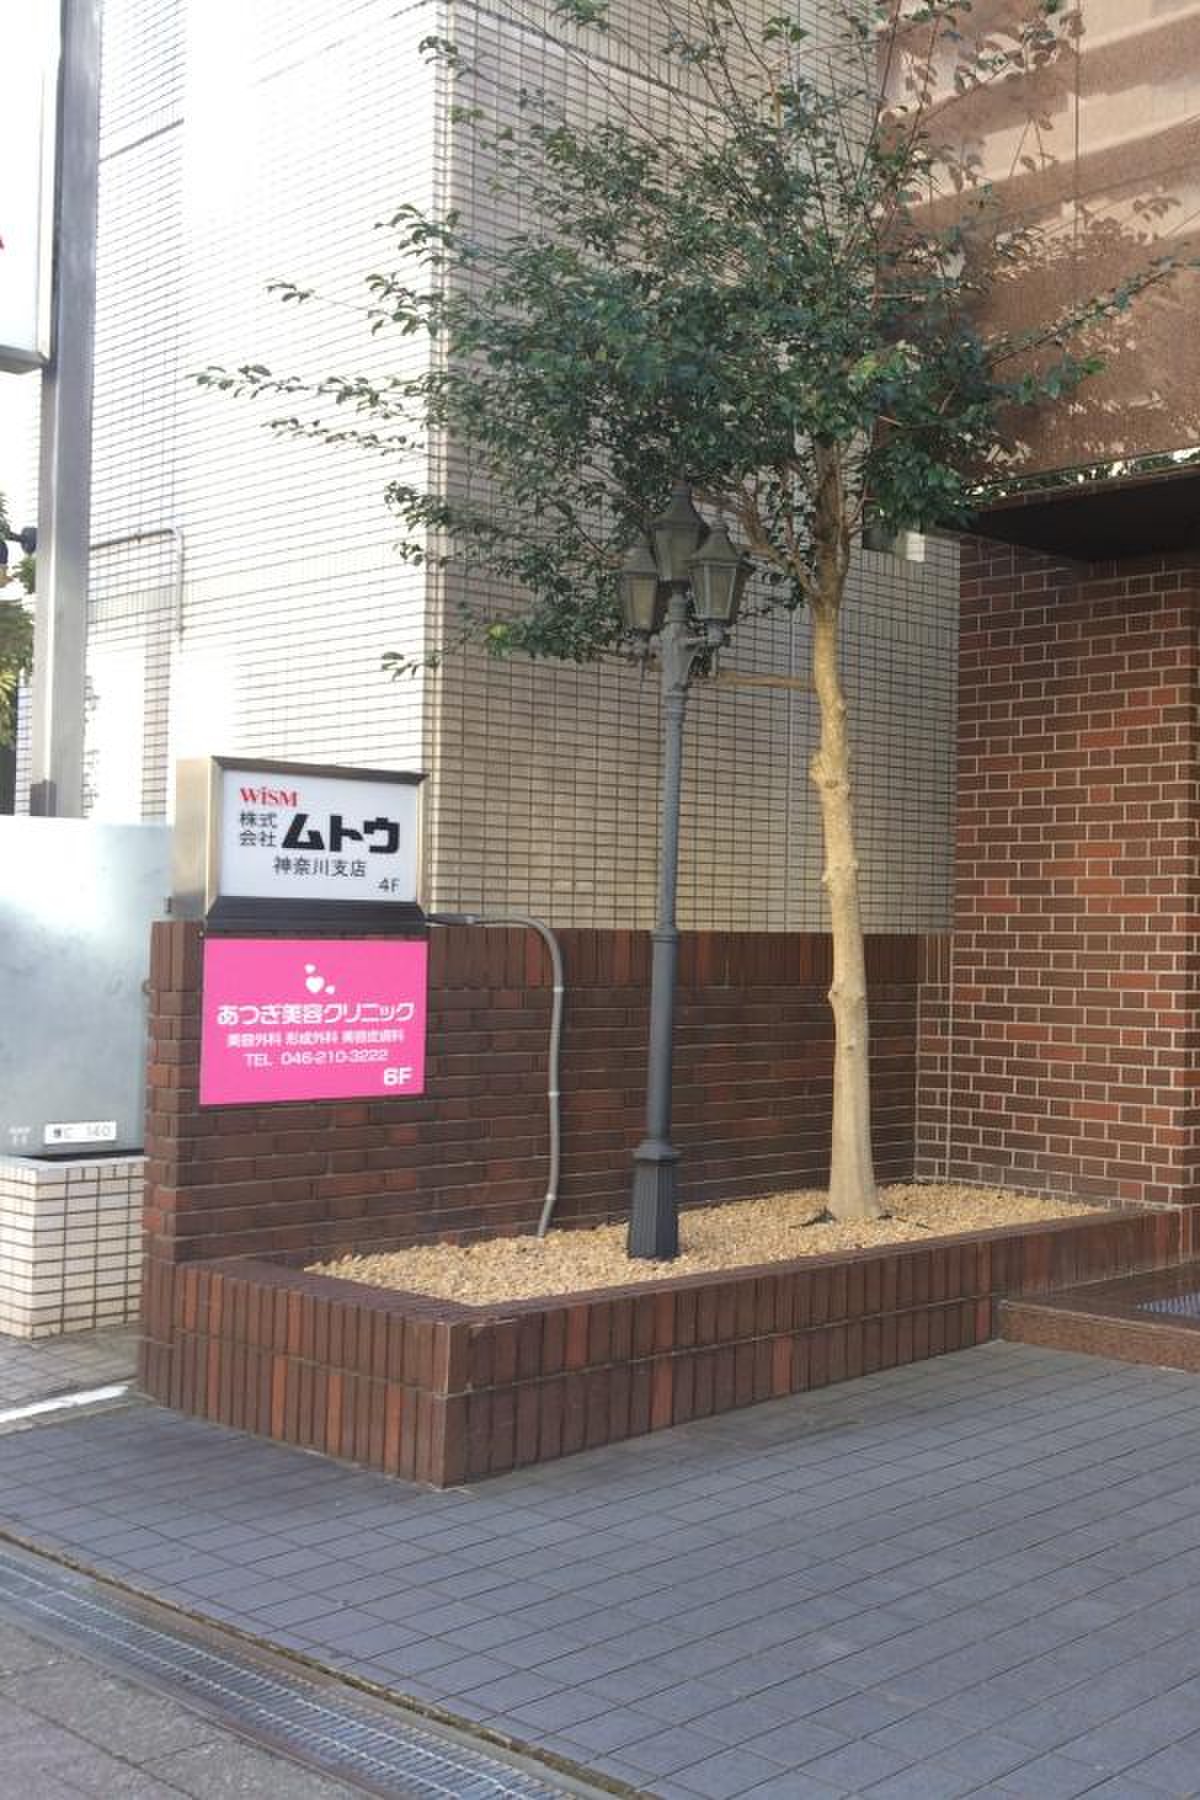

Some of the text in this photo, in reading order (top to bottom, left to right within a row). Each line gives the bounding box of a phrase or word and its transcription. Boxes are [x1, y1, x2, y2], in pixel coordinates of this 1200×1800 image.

[239, 811, 400, 854] 株式 ムトウ
[239, 830, 277, 848] 会社
[273, 856, 367, 878] 神奈川支店
[378, 877, 401, 893] 4F
[216, 1002, 415, 1025] あつぎ美容クリニック
[244, 1048, 389, 1068] TEL 046-210-3222
[383, 1067, 413, 1086] 6F
